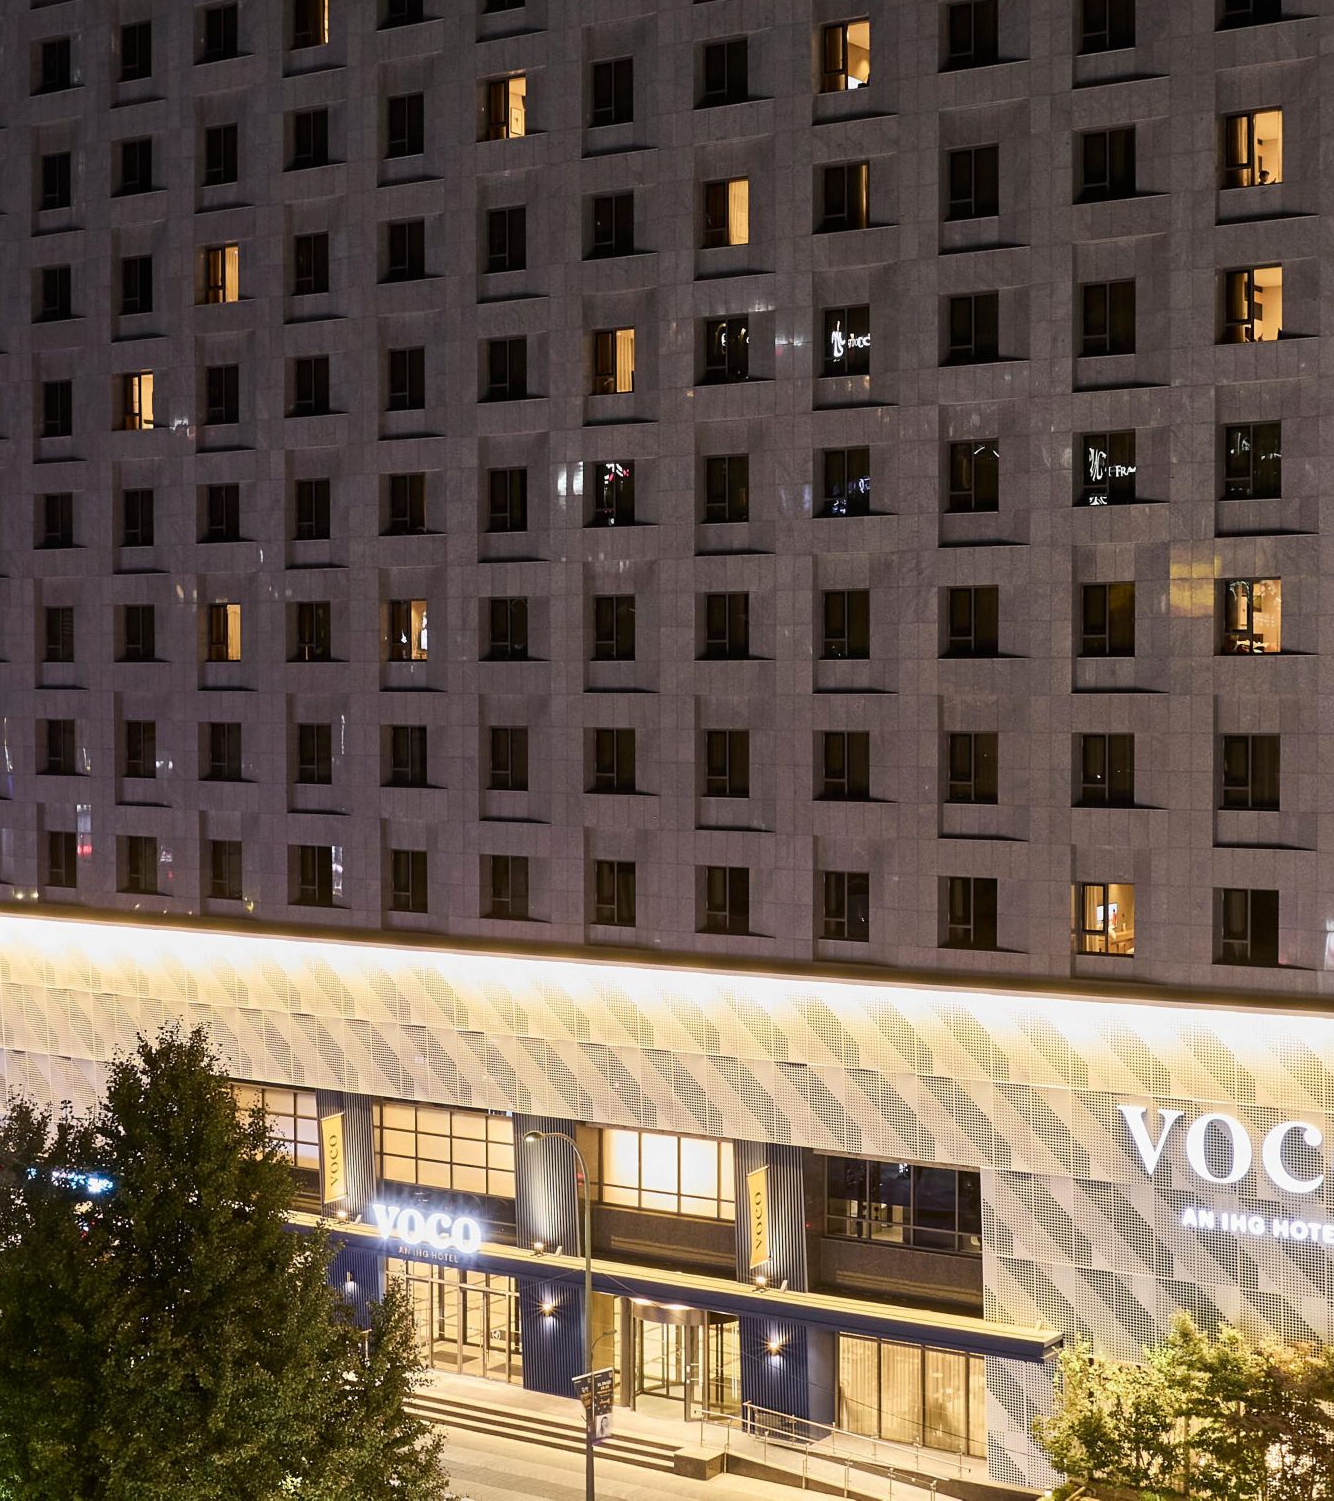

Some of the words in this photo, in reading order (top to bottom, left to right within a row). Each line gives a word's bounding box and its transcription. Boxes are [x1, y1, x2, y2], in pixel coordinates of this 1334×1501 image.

[1182, 1208, 1215, 1229] AN
[1221, 1212, 1266, 1235] IHG
[431, 1251, 459, 1263] HOTEL
